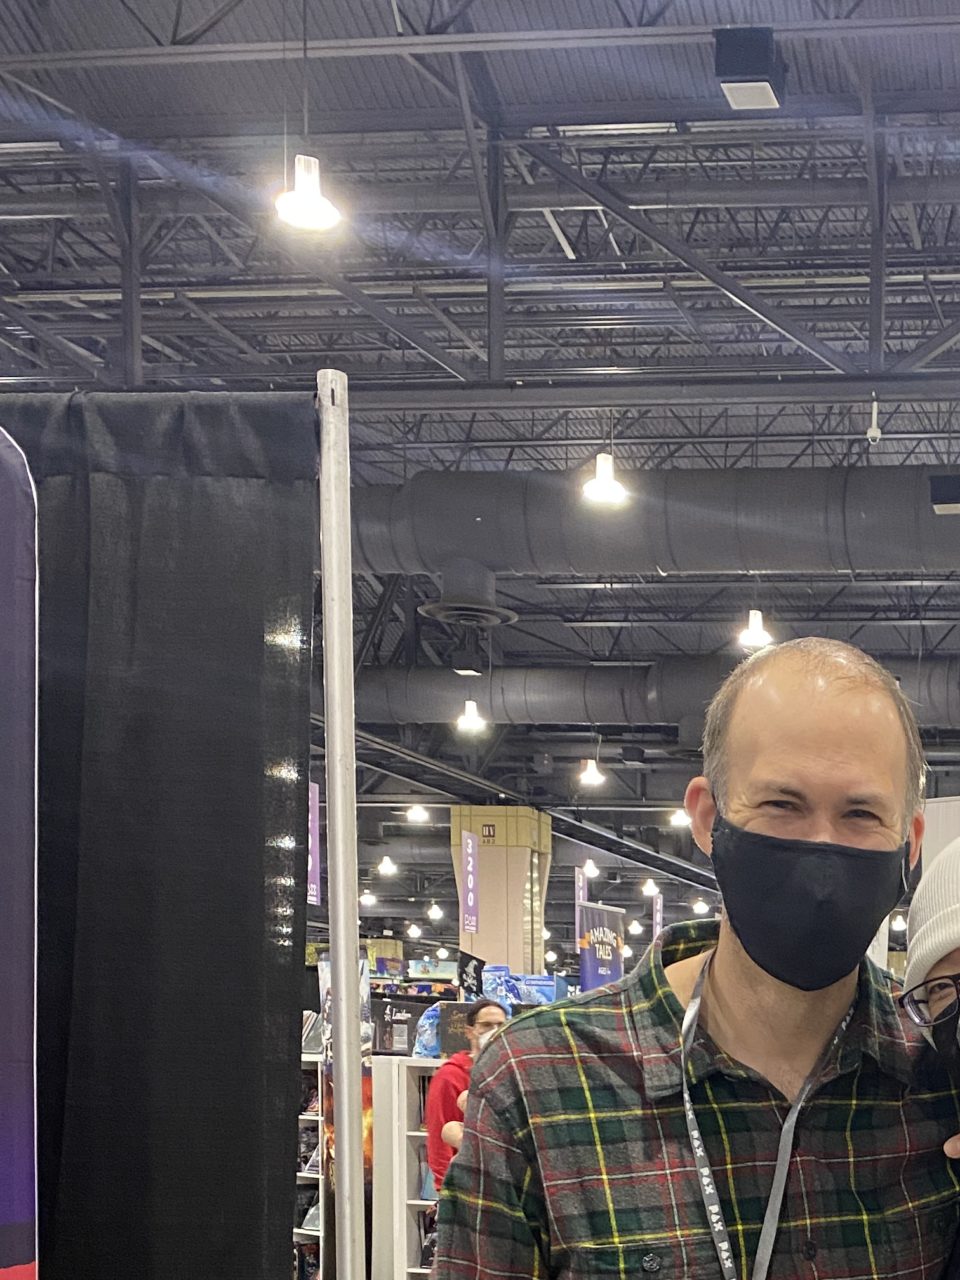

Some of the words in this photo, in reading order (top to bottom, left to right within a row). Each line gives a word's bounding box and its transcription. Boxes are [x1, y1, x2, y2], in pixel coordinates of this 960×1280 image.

[466, 839, 474, 907] 3200
[590, 926, 617, 948] AMAZING
[595, 943, 612, 960] TALES
[699, 1166, 714, 1195] PAX
[708, 1204, 723, 1232] PAX
[718, 1241, 732, 1268] PAX
